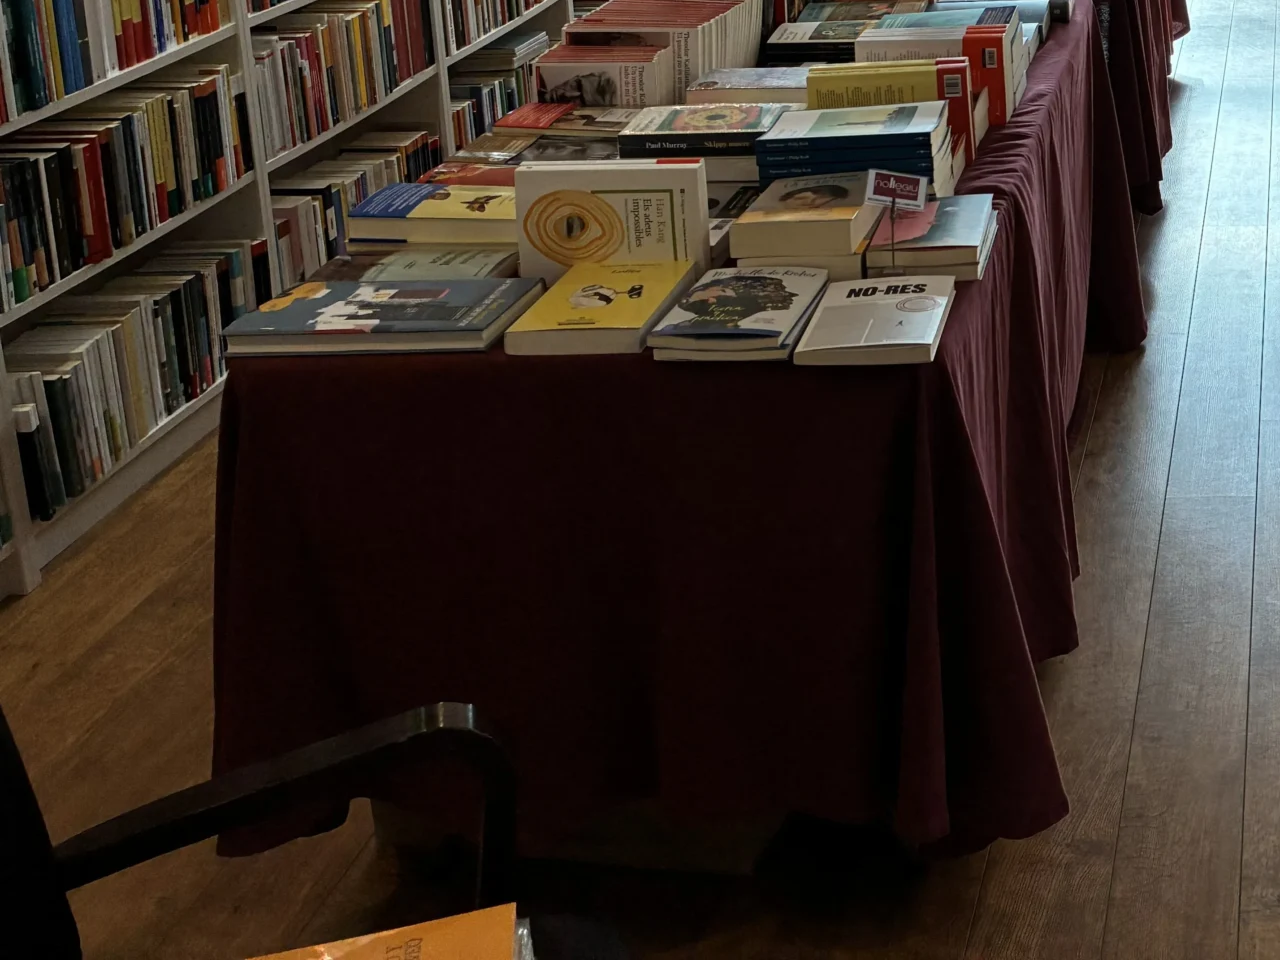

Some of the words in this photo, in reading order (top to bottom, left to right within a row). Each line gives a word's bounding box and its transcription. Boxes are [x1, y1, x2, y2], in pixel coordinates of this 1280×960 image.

[645, 141, 661, 149] Paul
[662, 141, 687, 151] Murray
[643, 198, 653, 212] Els
[655, 198, 665, 217] Han
[631, 198, 644, 248] impossibles
[643, 213, 654, 237] adeus
[655, 221, 667, 244] Kang
[846, 283, 927, 298] NO-RES
